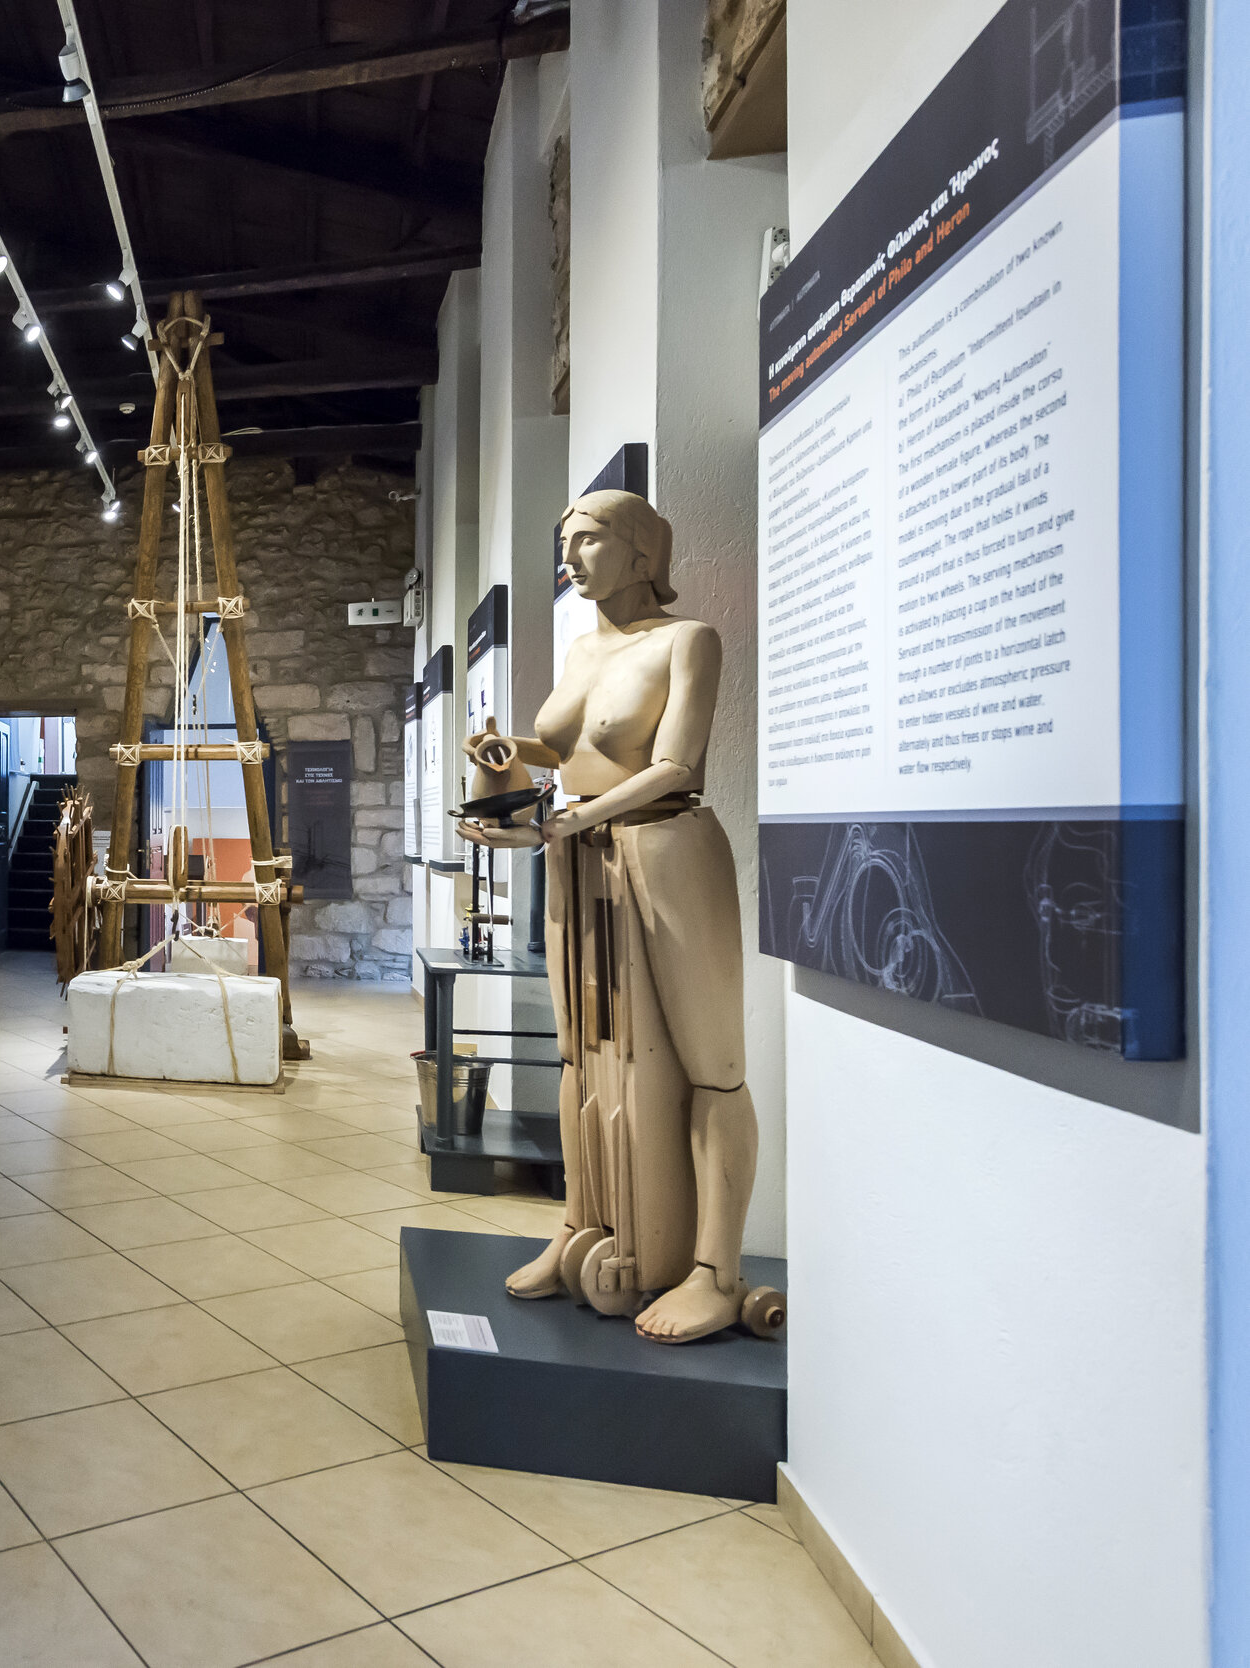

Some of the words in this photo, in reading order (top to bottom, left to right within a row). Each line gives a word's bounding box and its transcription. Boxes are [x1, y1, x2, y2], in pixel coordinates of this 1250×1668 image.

[768, 385, 780, 402] The
[781, 361, 804, 391] moving
[805, 321, 842, 368] automated
[844, 289, 875, 331] Servant
[877, 277, 886, 299] of
[888, 257, 912, 290] Philo
[914, 231, 933, 264] and
[936, 202, 969, 244] Heron
